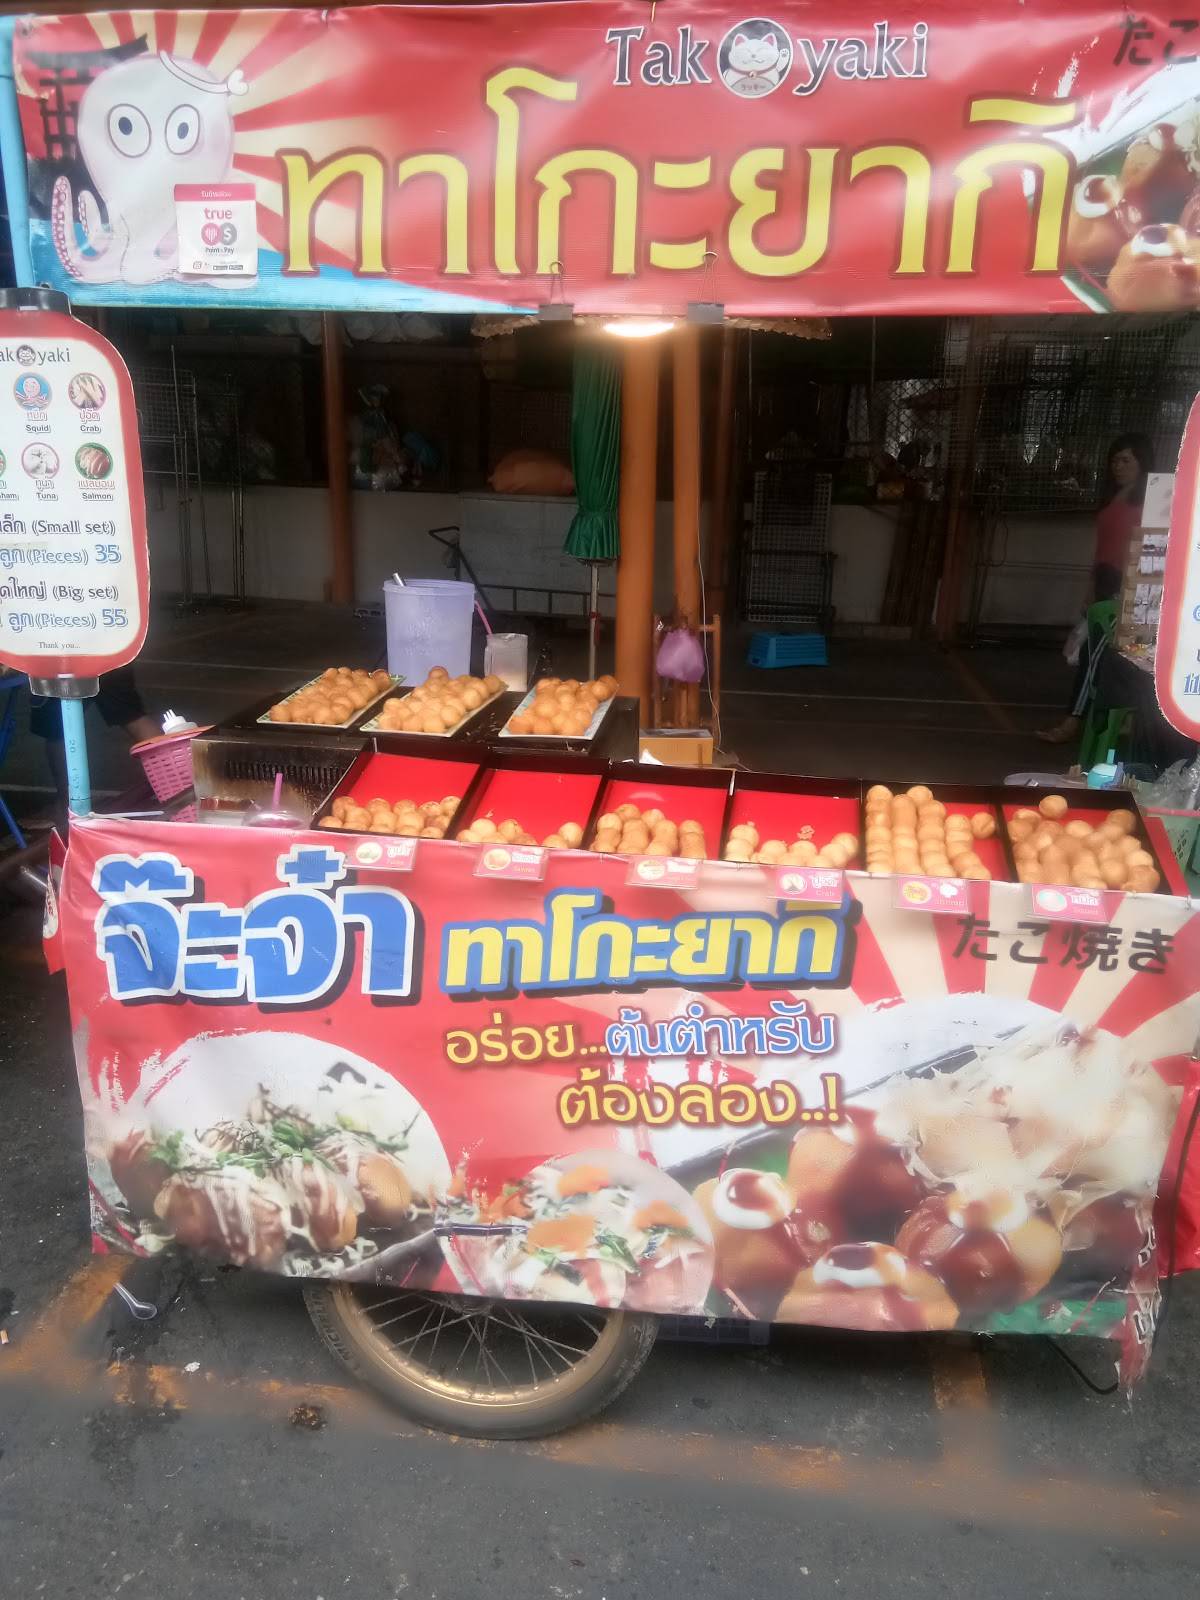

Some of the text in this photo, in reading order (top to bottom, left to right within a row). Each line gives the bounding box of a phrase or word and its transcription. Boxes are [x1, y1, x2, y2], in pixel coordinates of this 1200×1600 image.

[279, 65, 1077, 278] ทาโกะยากิ
[204, 207, 233, 220] true
[25, 424, 49, 434] Squid
[80, 424, 101, 433] Crab
[36, 492, 57, 500] Tuna
[82, 492, 113, 500] Salmon
[32, 519, 81, 536] (Small
[85, 520, 116, 536] set)
[95, 543, 121, 563] 35
[53, 585, 84, 602] (Big
[88, 585, 118, 601] set)
[102, 608, 128, 627] 55
[38, 641, 59, 649] Thank
[952, 913, 1175, 975] たこ焼き
